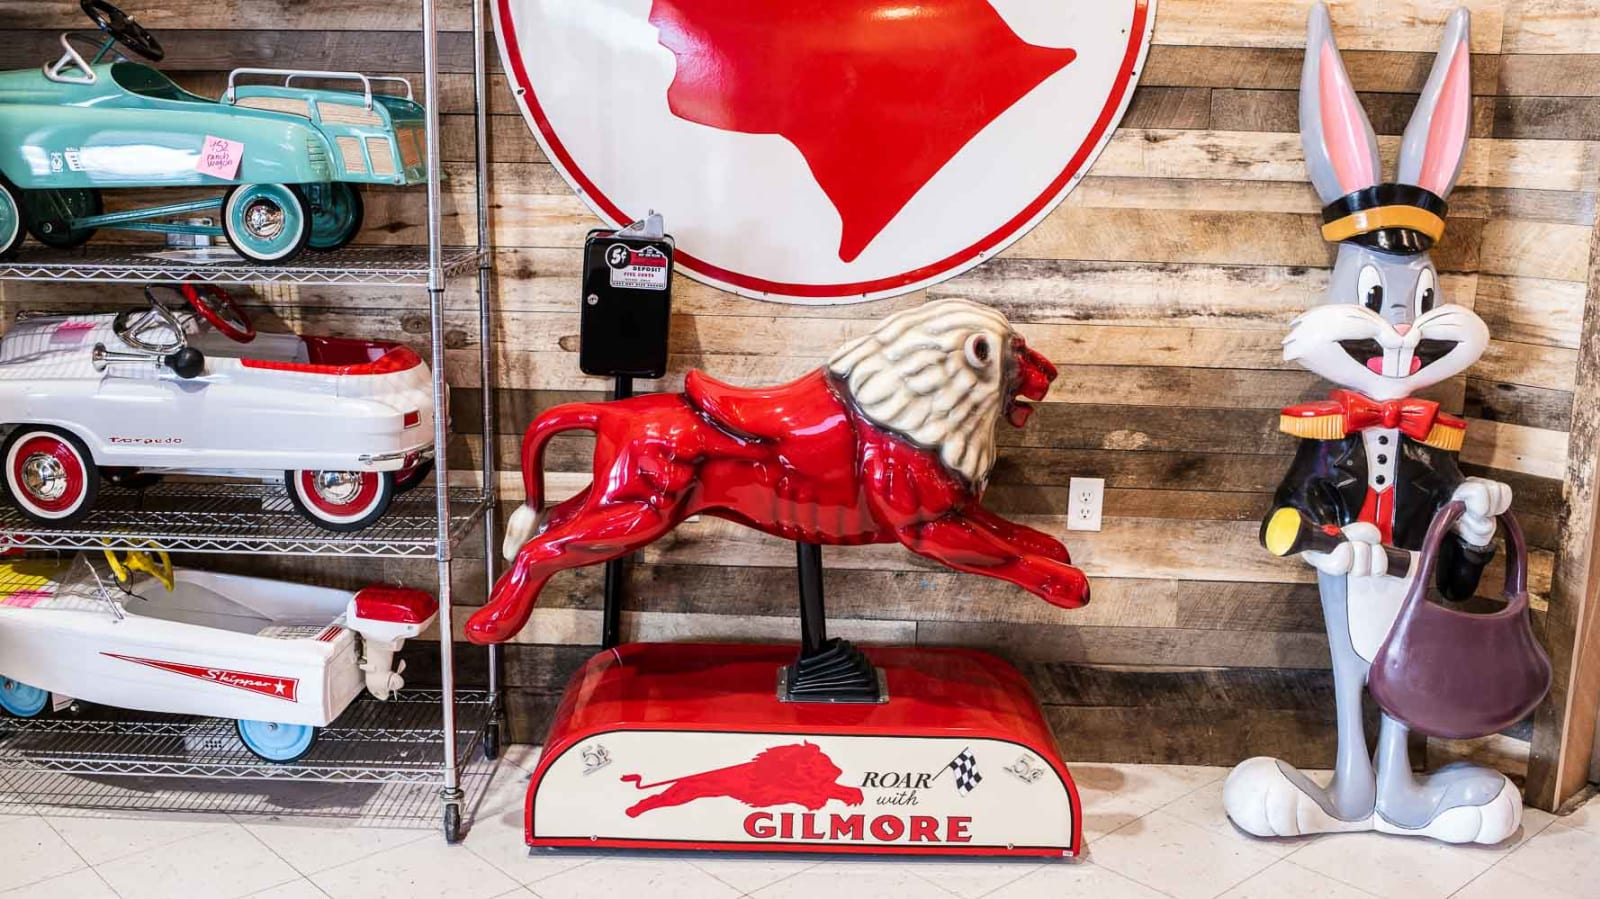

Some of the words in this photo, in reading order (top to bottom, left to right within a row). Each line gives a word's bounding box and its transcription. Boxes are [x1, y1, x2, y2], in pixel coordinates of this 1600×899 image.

[611, 248, 627, 264] 5¢
[201, 669, 271, 687] Skipper
[861, 771, 932, 789] ROAR
[876, 790, 919, 806] with
[743, 811, 973, 843] GILMORE
